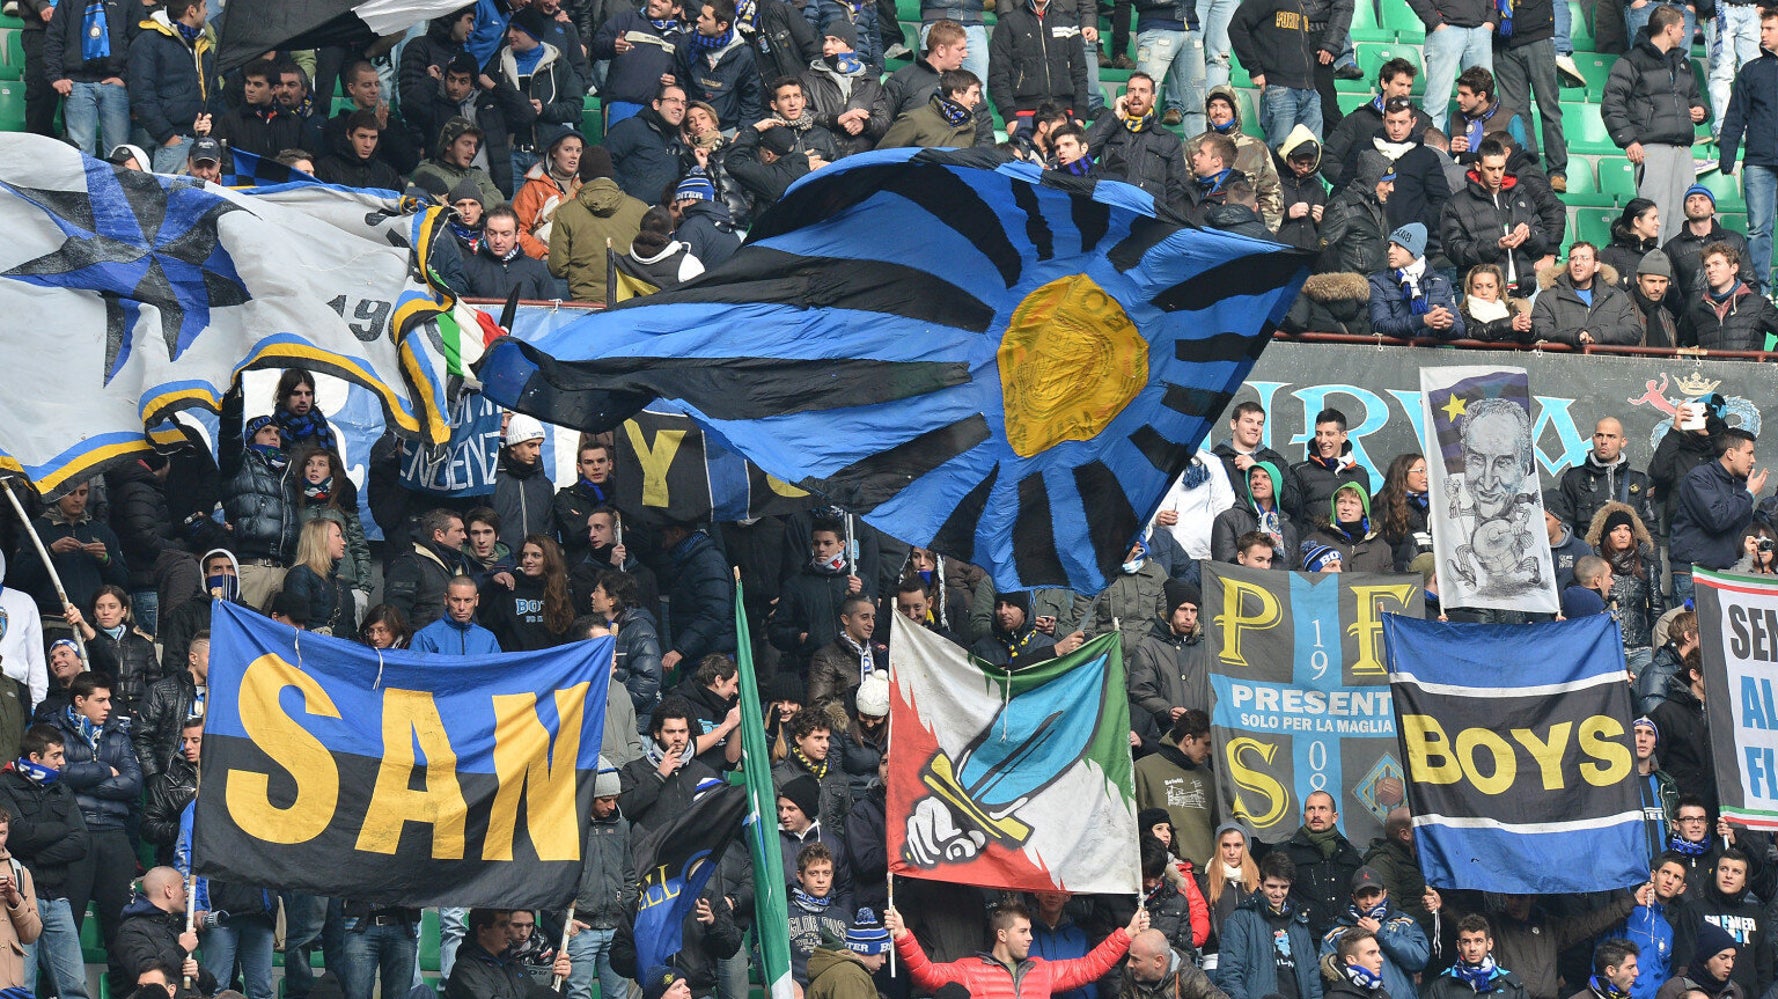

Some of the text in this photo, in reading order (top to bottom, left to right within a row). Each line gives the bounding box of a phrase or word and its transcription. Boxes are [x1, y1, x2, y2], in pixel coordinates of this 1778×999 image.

[623, 418, 687, 508] Y
[1319, 550, 1343, 567] BO
[515, 598, 544, 615] BO
[1213, 576, 1418, 676] P F
[1232, 684, 1392, 717] PRESENT
[1241, 713, 1393, 733] SOLO PER LA MAGLIA
[226, 653, 590, 861] SAN
[1226, 736, 1290, 829] S
[1402, 714, 1633, 795] BOYS
